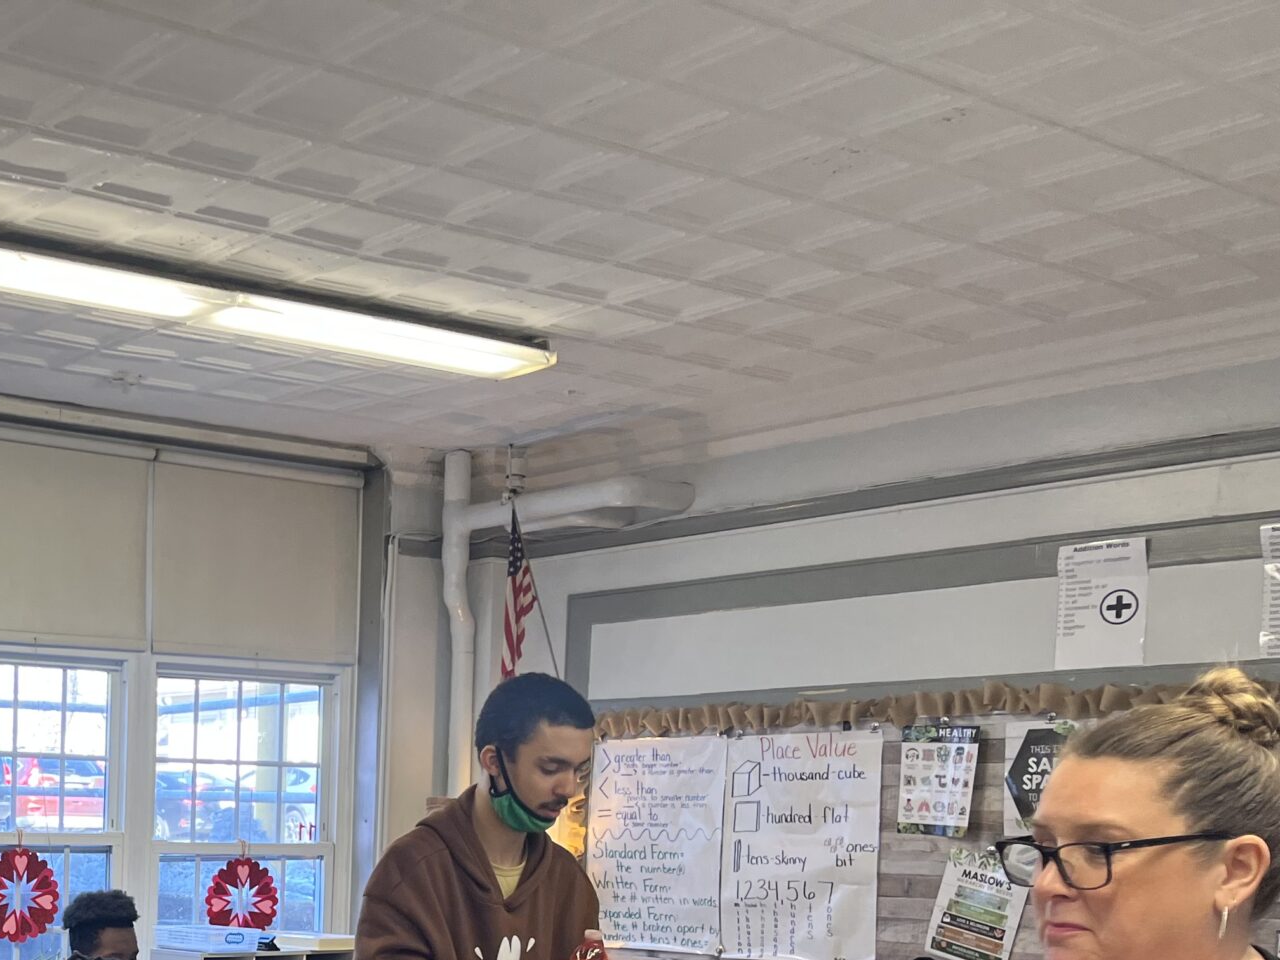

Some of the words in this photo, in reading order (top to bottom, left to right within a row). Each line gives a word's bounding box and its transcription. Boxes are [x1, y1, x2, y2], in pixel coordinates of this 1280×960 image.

[939, 728, 977, 737] HEALTHY
[651, 747, 671, 761] than
[760, 736, 801, 761] Place
[806, 733, 857, 759] Value
[1030, 745, 1051, 754] THIS
[1028, 757, 1058, 773] SA
[615, 780, 632, 795] less
[637, 780, 657, 795] than
[1022, 774, 1051, 790] SPA
[1028, 793, 1038, 801] TO
[616, 806, 642, 827] equal
[648, 808, 659, 821] to
[766, 803, 812, 824] hundred
[821, 803, 849, 824] flat
[593, 841, 646, 860] Standard
[616, 860, 632, 873] the
[836, 854, 856, 867] bit
[592, 871, 638, 890] Written
[961, 869, 1012, 890] MASLOW'S
[641, 894, 675, 904] written
[642, 921, 672, 932] broken
[677, 924, 705, 935] apart
[603, 933, 636, 942] undreds
[650, 933, 669, 943] tens
